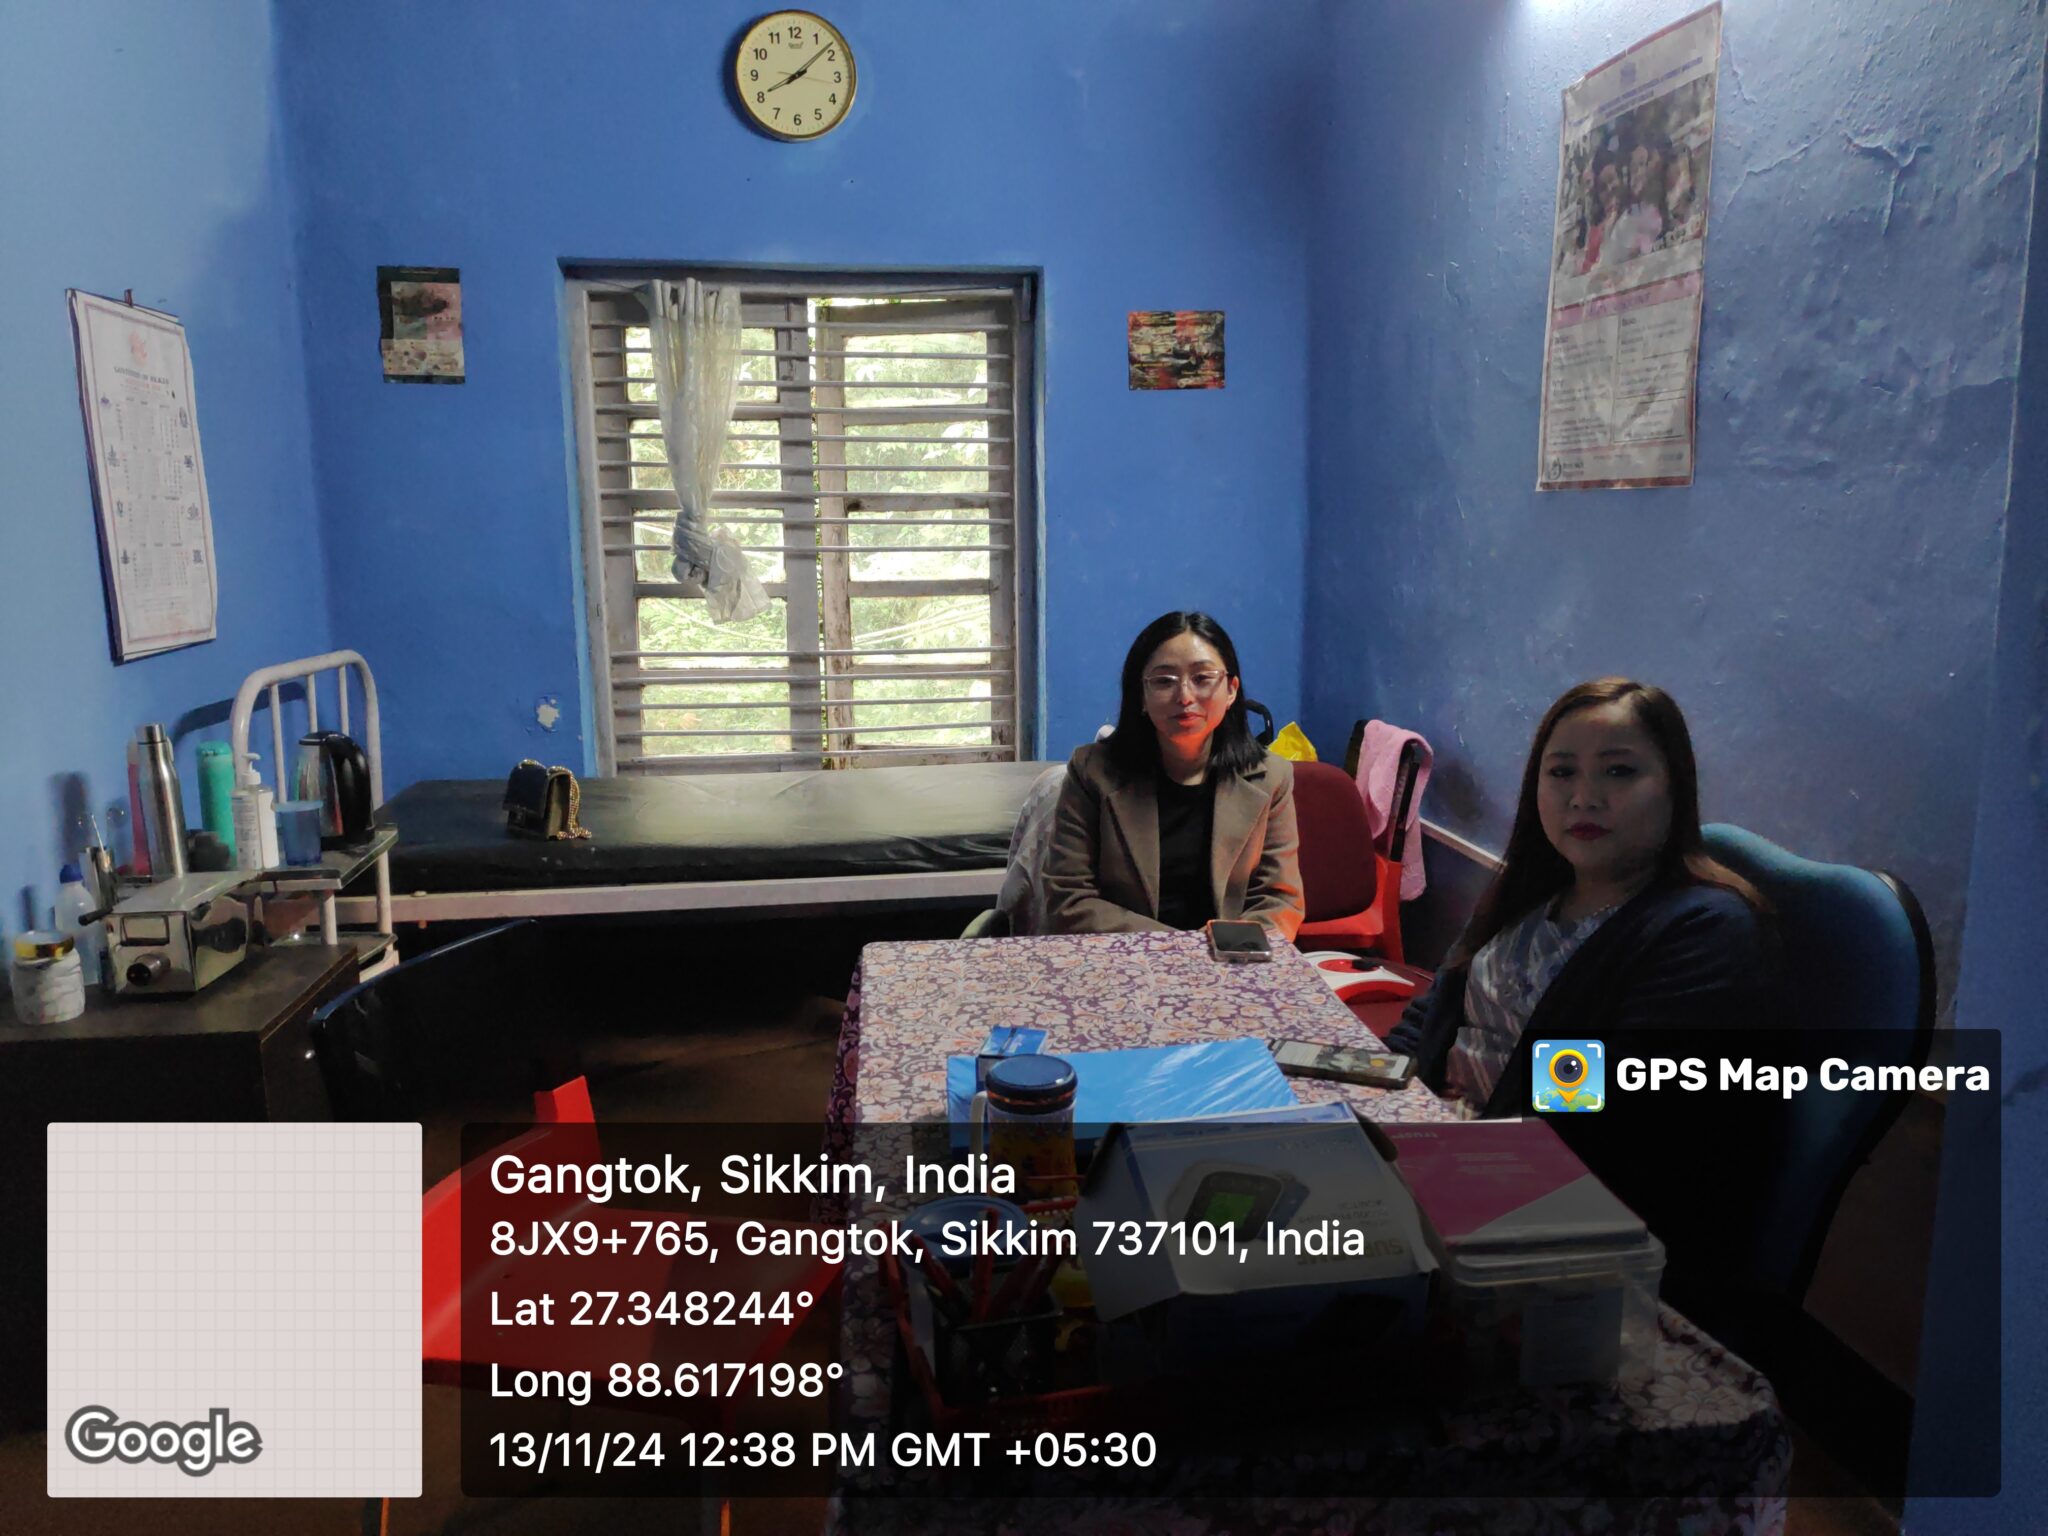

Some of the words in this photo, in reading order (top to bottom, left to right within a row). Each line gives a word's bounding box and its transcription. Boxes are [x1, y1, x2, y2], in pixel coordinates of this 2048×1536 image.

[768, 32, 780, 45] 11
[787, 26, 802, 39] 12
[813, 33, 819, 45] 1
[753, 48, 768, 60] 10
[827, 49, 836, 62] 2
[750, 69, 759, 81] 9
[833, 71, 842, 83] 3
[756, 91, 765, 104] 8
[828, 93, 837, 105] 4
[773, 107, 781, 120] 7
[814, 108, 822, 121] 5
[793, 114, 802, 126] 6
